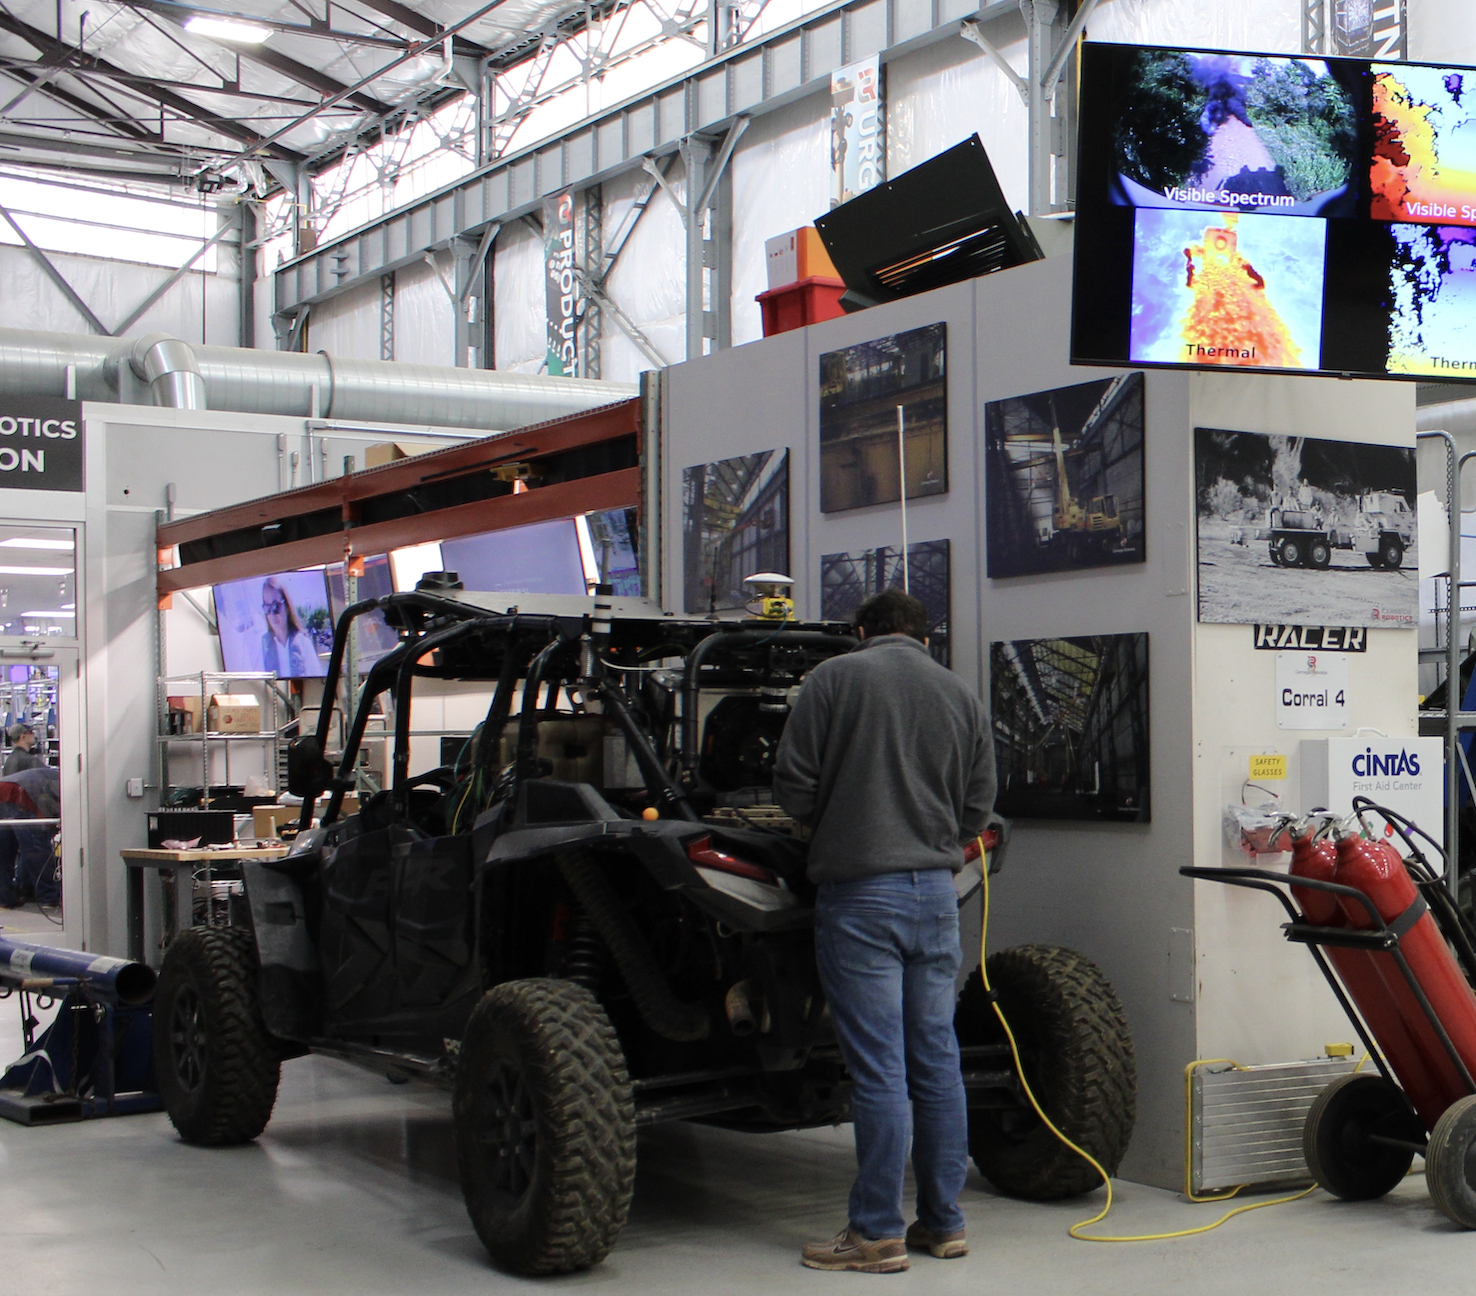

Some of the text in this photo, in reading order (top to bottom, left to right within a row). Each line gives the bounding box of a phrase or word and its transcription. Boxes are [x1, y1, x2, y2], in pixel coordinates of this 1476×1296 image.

[1164, 186, 1295, 207] Visible Spectrum
[1406, 202, 1457, 218] Visible
[560, 228, 577, 378] PRODUCT
[1185, 343, 1256, 359] Thermal
[0, 416, 77, 440] OTICS
[0, 447, 45, 472] ON
[1257, 625, 1364, 650] RACER
[1282, 688, 1345, 707] Corral 4
[1255, 758, 1280, 766] SAFETY
[1253, 768, 1283, 777] GLASSES
[1353, 780, 1422, 792] First Aid Center
